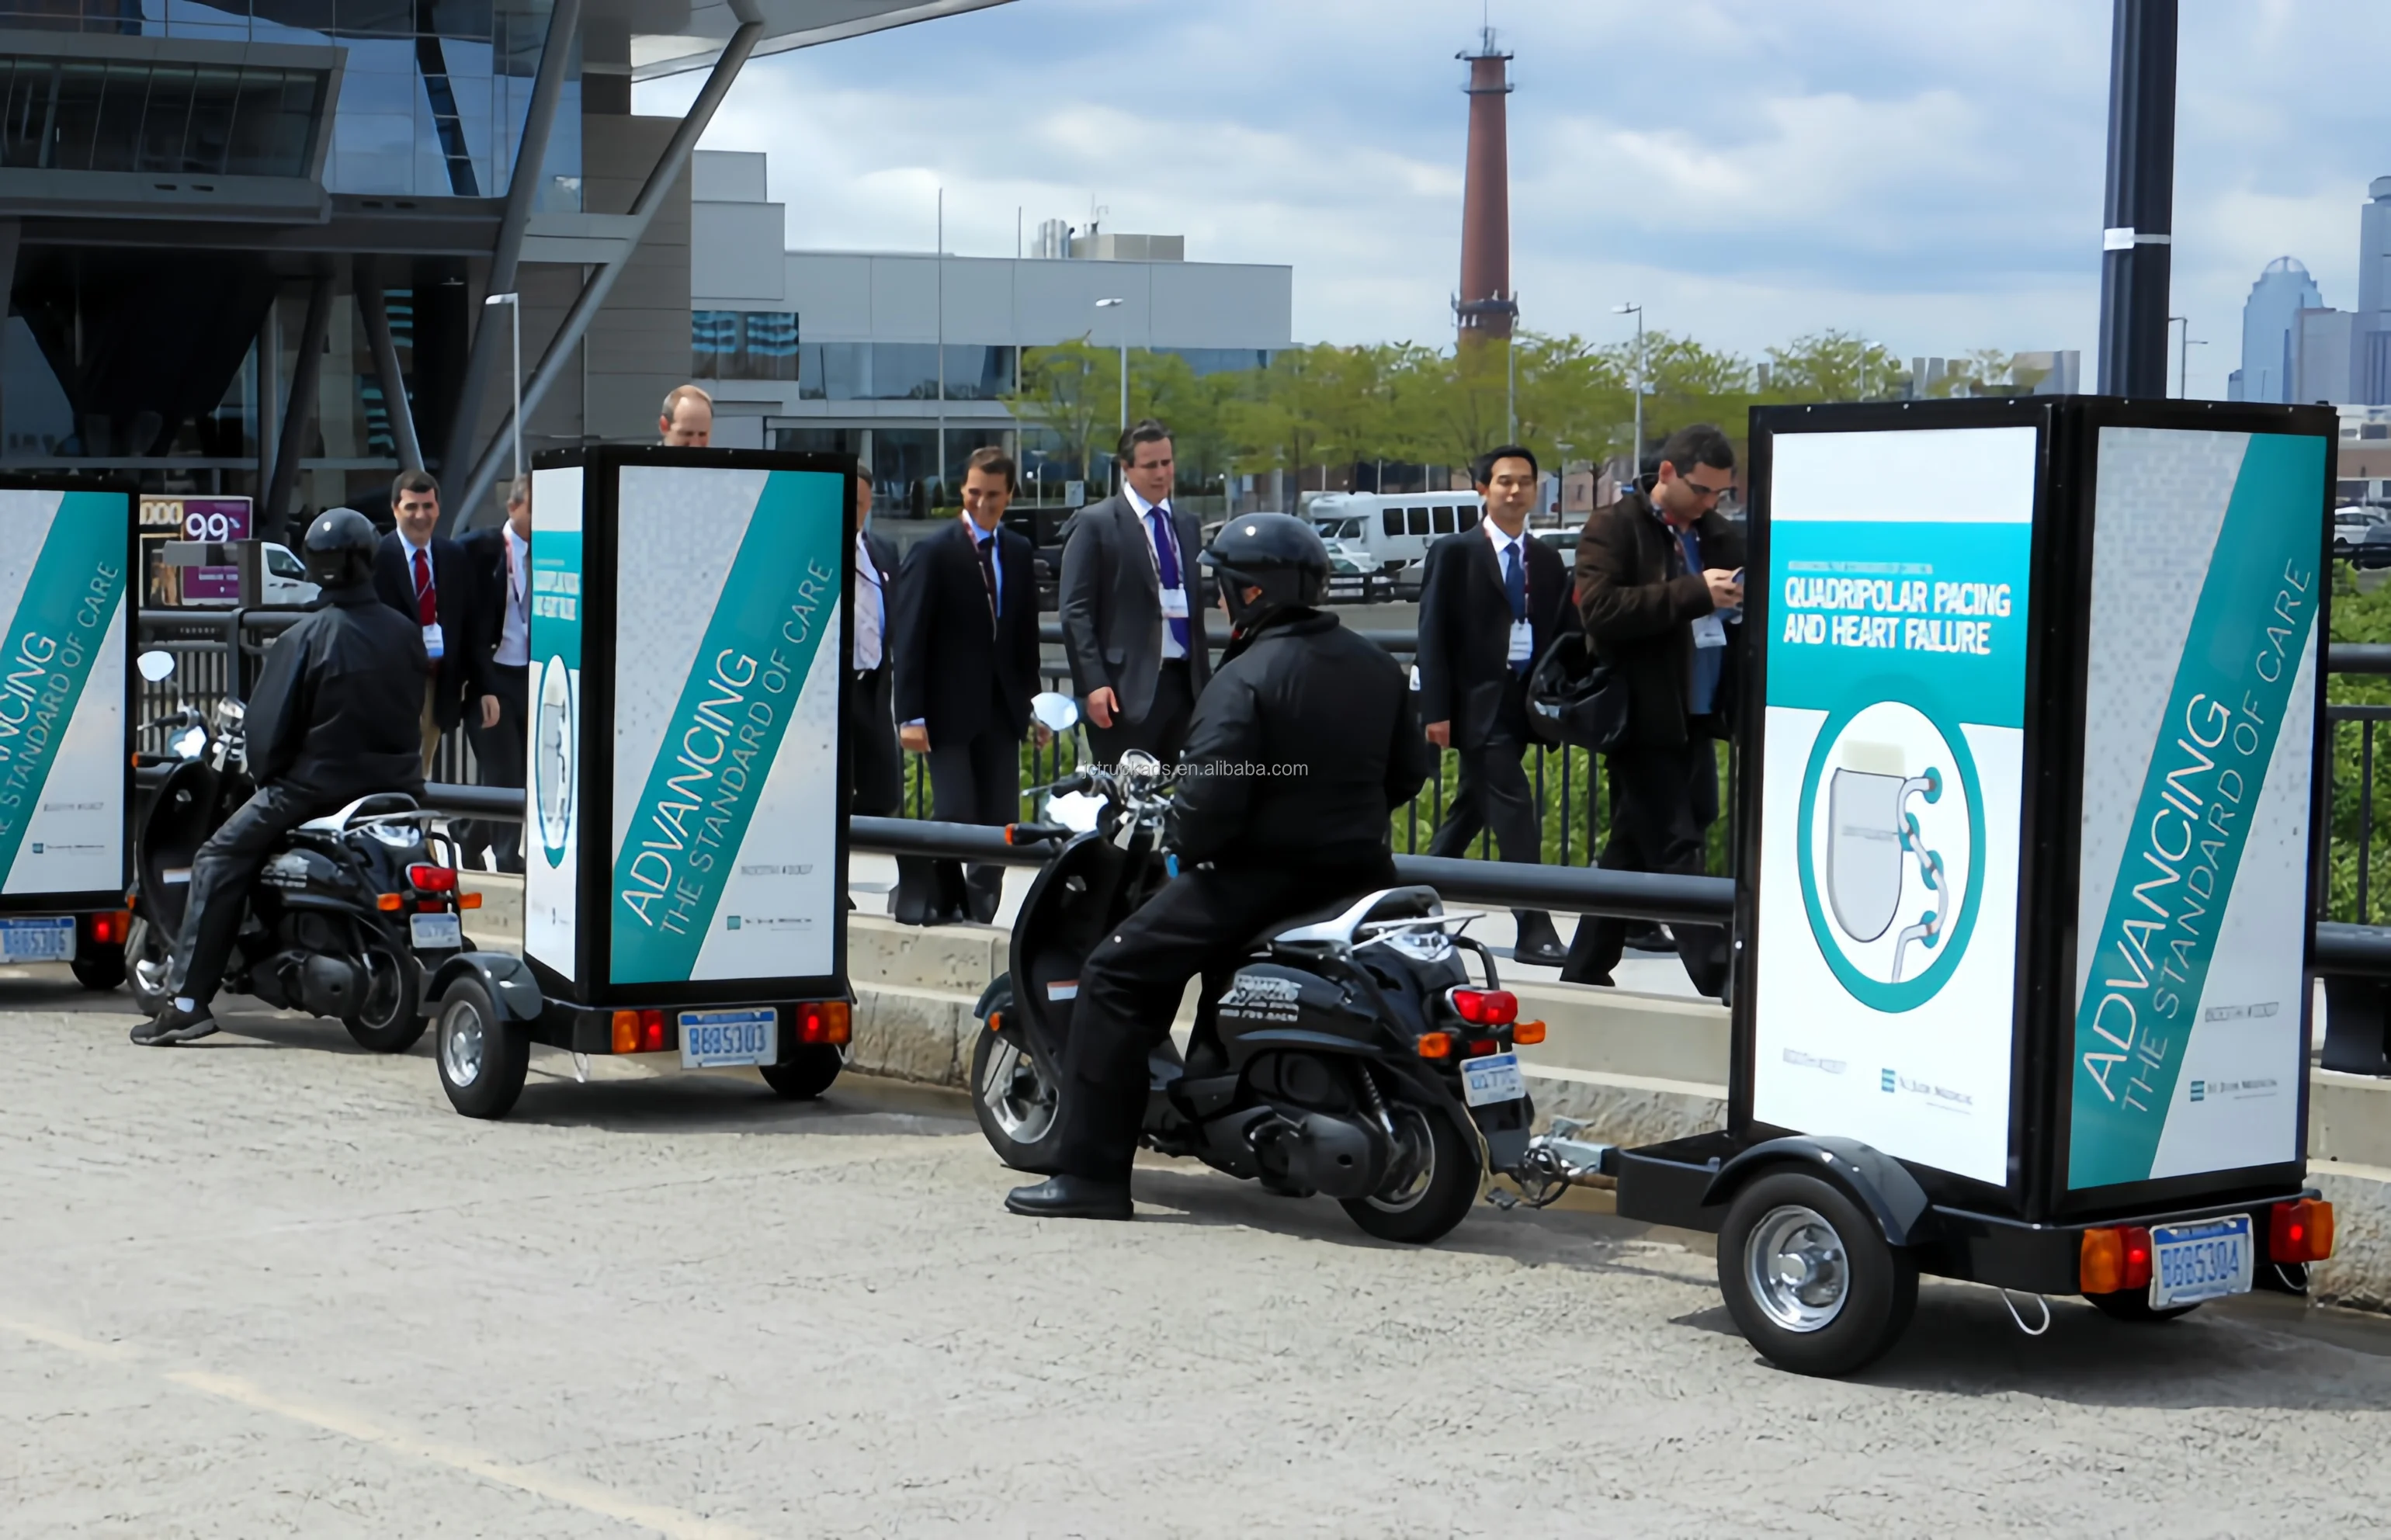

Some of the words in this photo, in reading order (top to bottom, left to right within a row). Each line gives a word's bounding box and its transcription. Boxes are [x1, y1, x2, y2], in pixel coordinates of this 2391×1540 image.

[1, 672, 71, 808] STANDARD
[60, 631, 85, 668] OF
[76, 561, 119, 628] CARE
[1782, 613, 1827, 644] AND
[1831, 616, 1900, 649] HEART
[1904, 618, 1992, 655] FAILURE
[1784, 576, 1929, 613] QUADRIPOLAR
[1933, 581, 2011, 617] PACING
[621, 647, 758, 927] ADVANCING
[659, 875, 704, 935] THE
[689, 700, 774, 873] STANDARD
[762, 647, 792, 694] OF
[783, 557, 833, 644] CARE
[2121, 1026, 2168, 1112] THE
[2153, 768, 2244, 1020] STANDARD
[2233, 689, 2264, 756] OF
[2255, 558, 2311, 683] CARE
[2083, 693, 2231, 1102] ADVANCING
